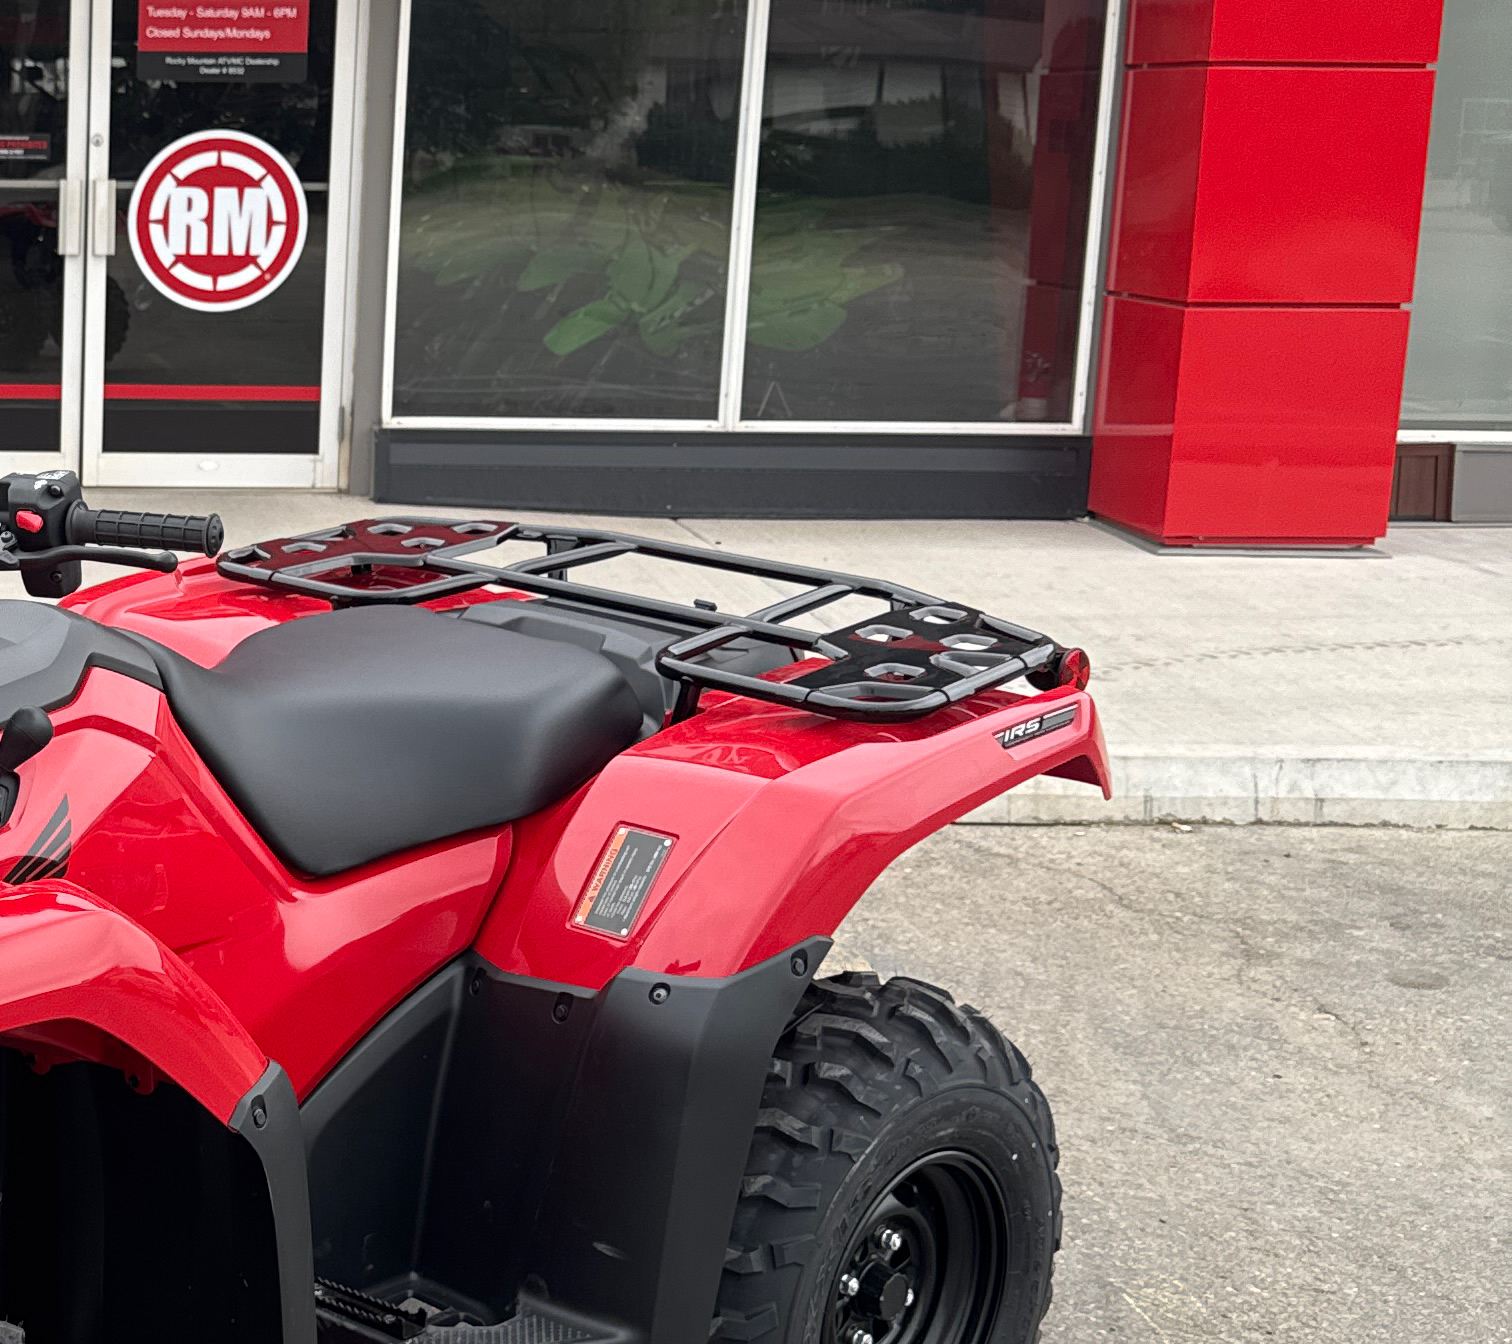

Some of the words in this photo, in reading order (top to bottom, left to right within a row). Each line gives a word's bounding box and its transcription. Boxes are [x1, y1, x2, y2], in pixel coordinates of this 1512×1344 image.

[146, 6, 187, 21] Tuesday
[195, 6, 239, 21] Saturday
[145, 26, 181, 39] Closed
[168, 186, 268, 256] RM
[1003, 716, 1041, 743] IRS
[590, 846, 619, 894] WARNING
